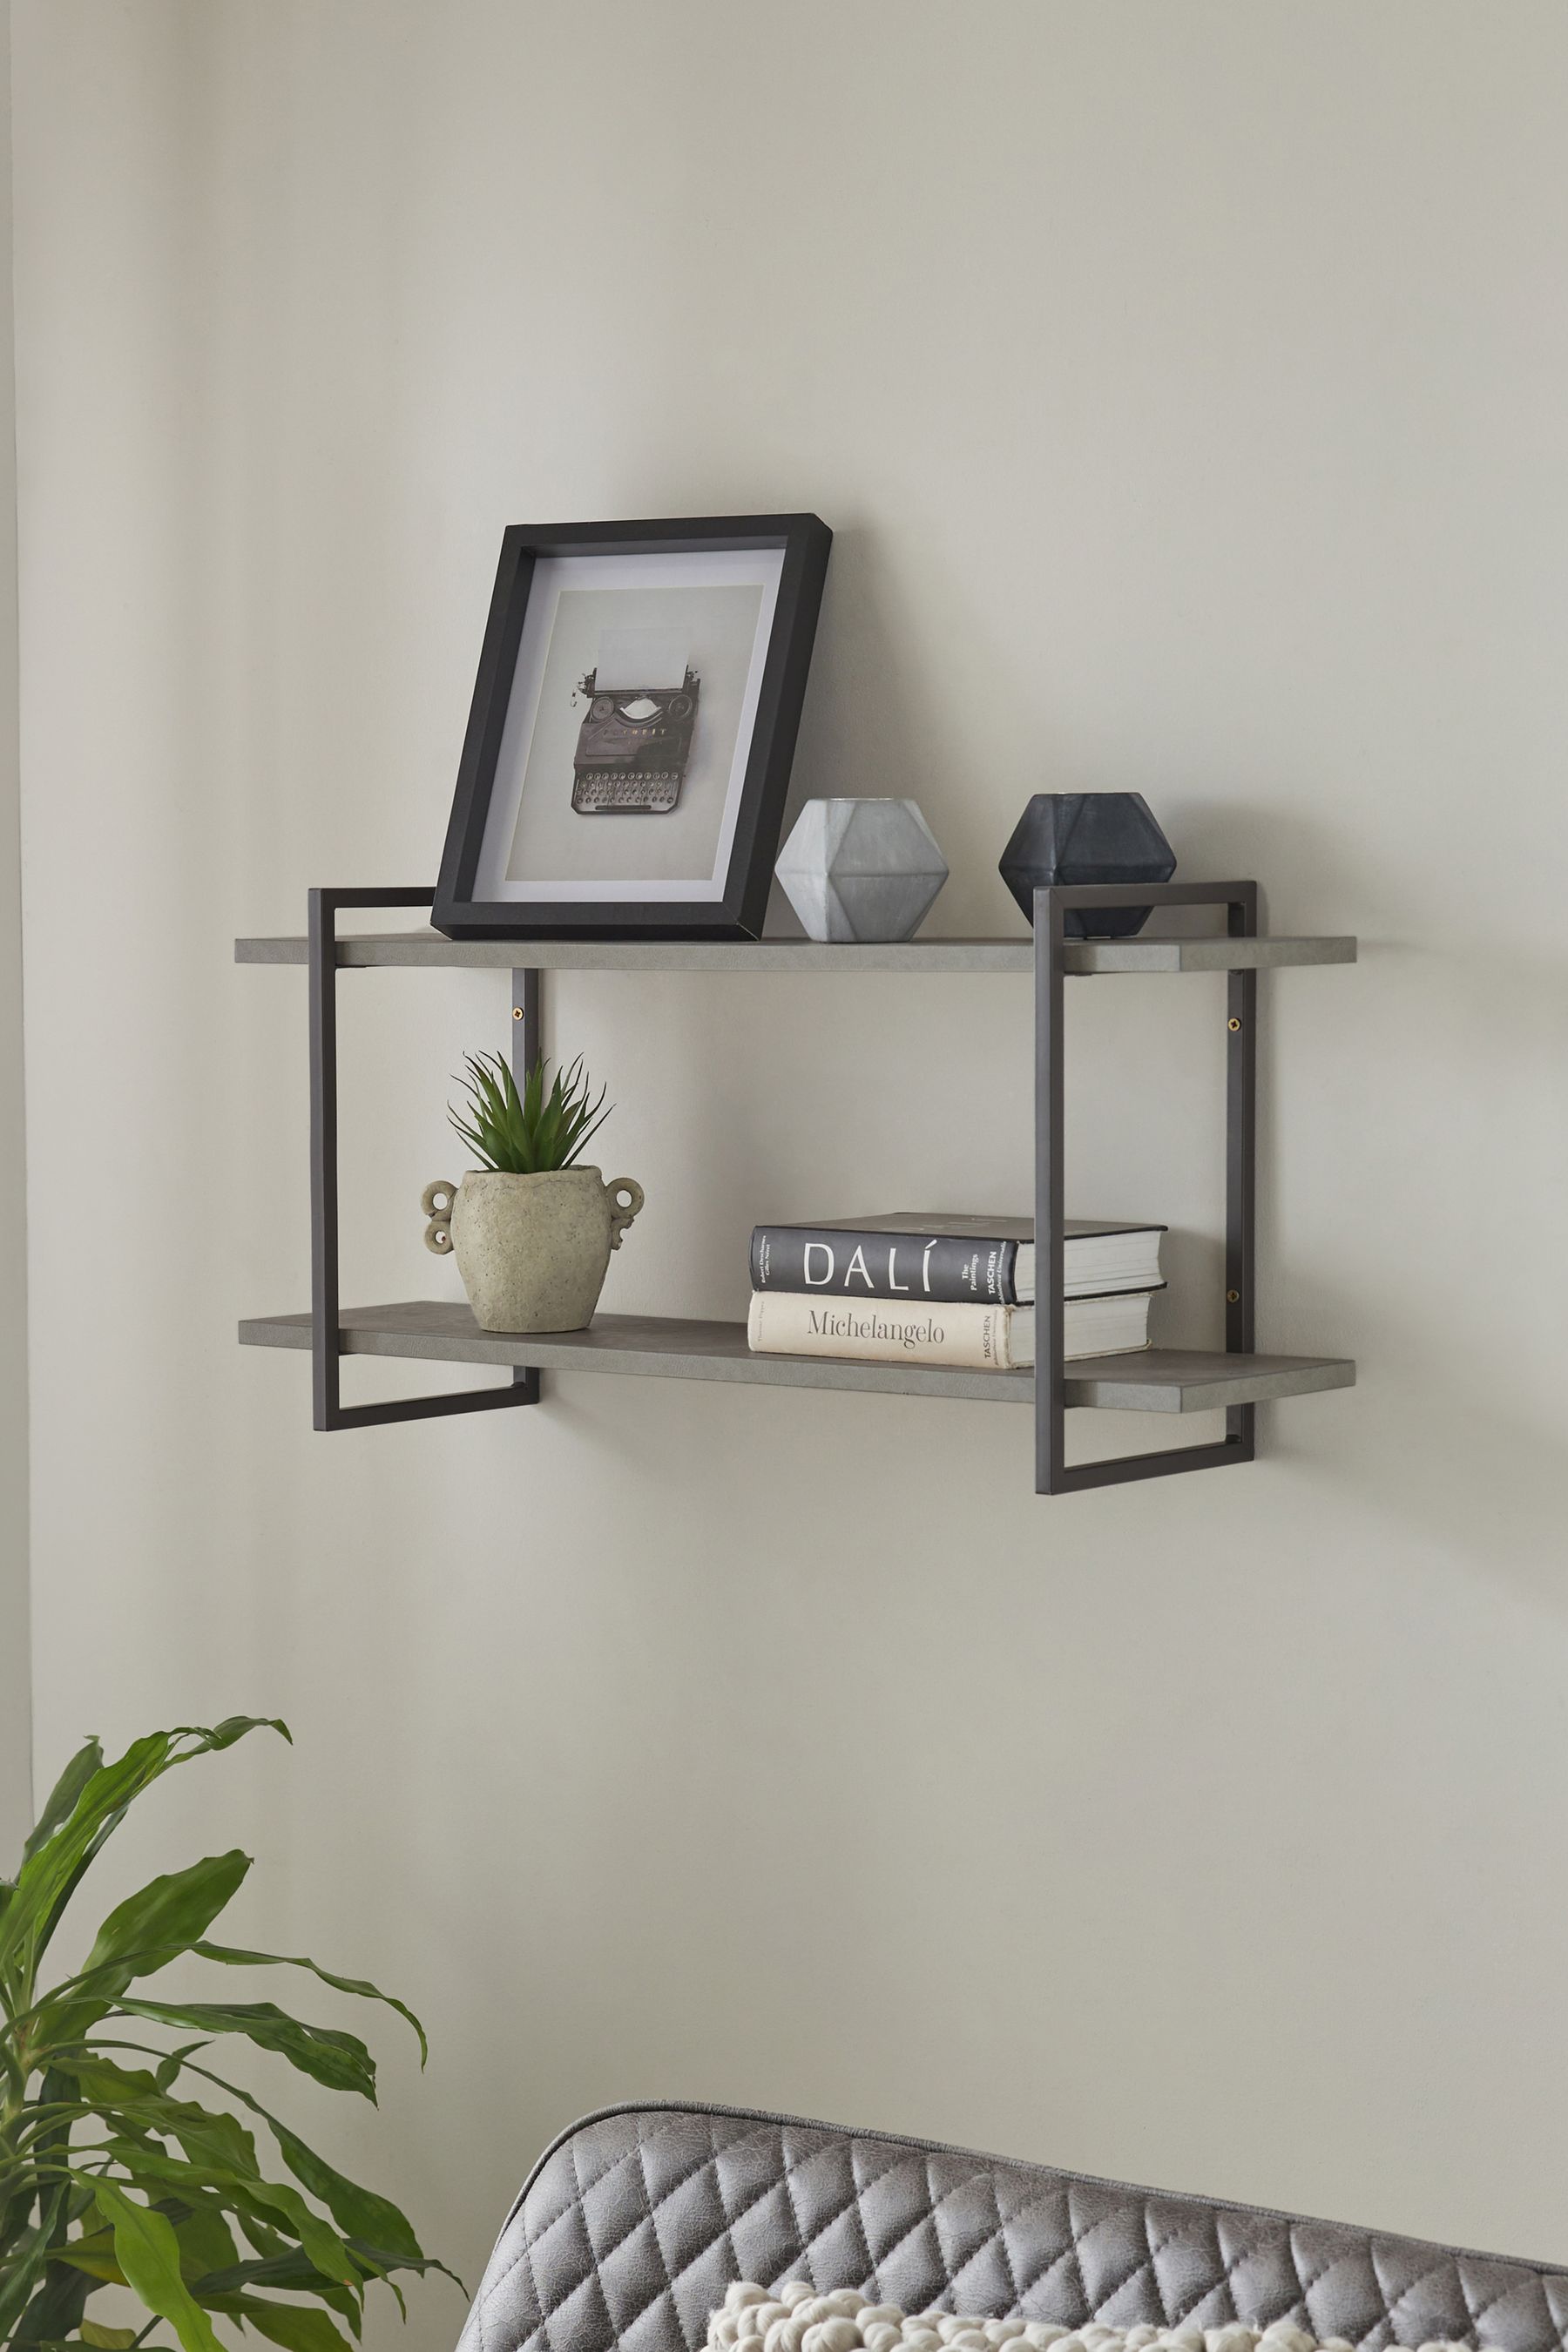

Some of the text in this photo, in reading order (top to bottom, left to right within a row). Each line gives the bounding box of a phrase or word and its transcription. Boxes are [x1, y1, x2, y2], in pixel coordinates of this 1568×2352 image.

[804, 1239, 937, 1293] DALÍ
[969, 1254, 979, 1292] Paintings
[987, 1251, 997, 1294] TASCHEN
[807, 1310, 945, 1349] Michelangelo
[983, 1315, 991, 1360] TASCHEN
